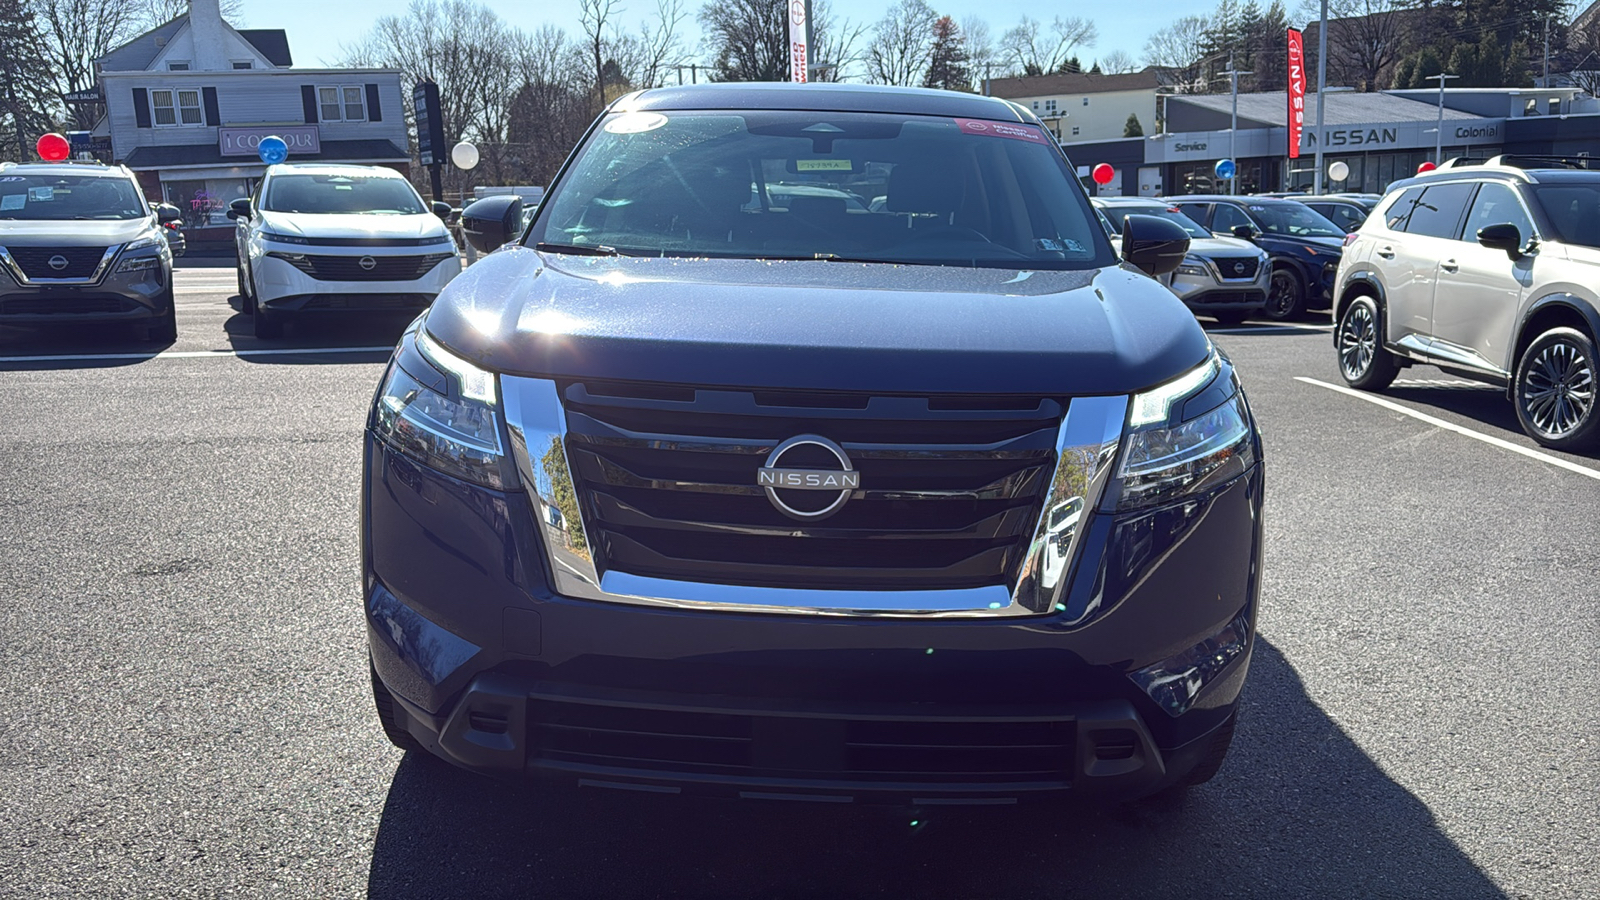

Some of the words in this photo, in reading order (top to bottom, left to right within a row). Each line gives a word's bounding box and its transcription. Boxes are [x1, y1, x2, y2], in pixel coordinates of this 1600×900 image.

[992, 124, 1028, 134] Nissan
[995, 128, 1039, 140] Certified
[1455, 125, 1498, 139] Colonial
[236, 133, 313, 149] COOUR
[1307, 127, 1397, 147] NISSAN
[1174, 142, 1207, 152] Service
[760, 471, 857, 487] NISSAN
